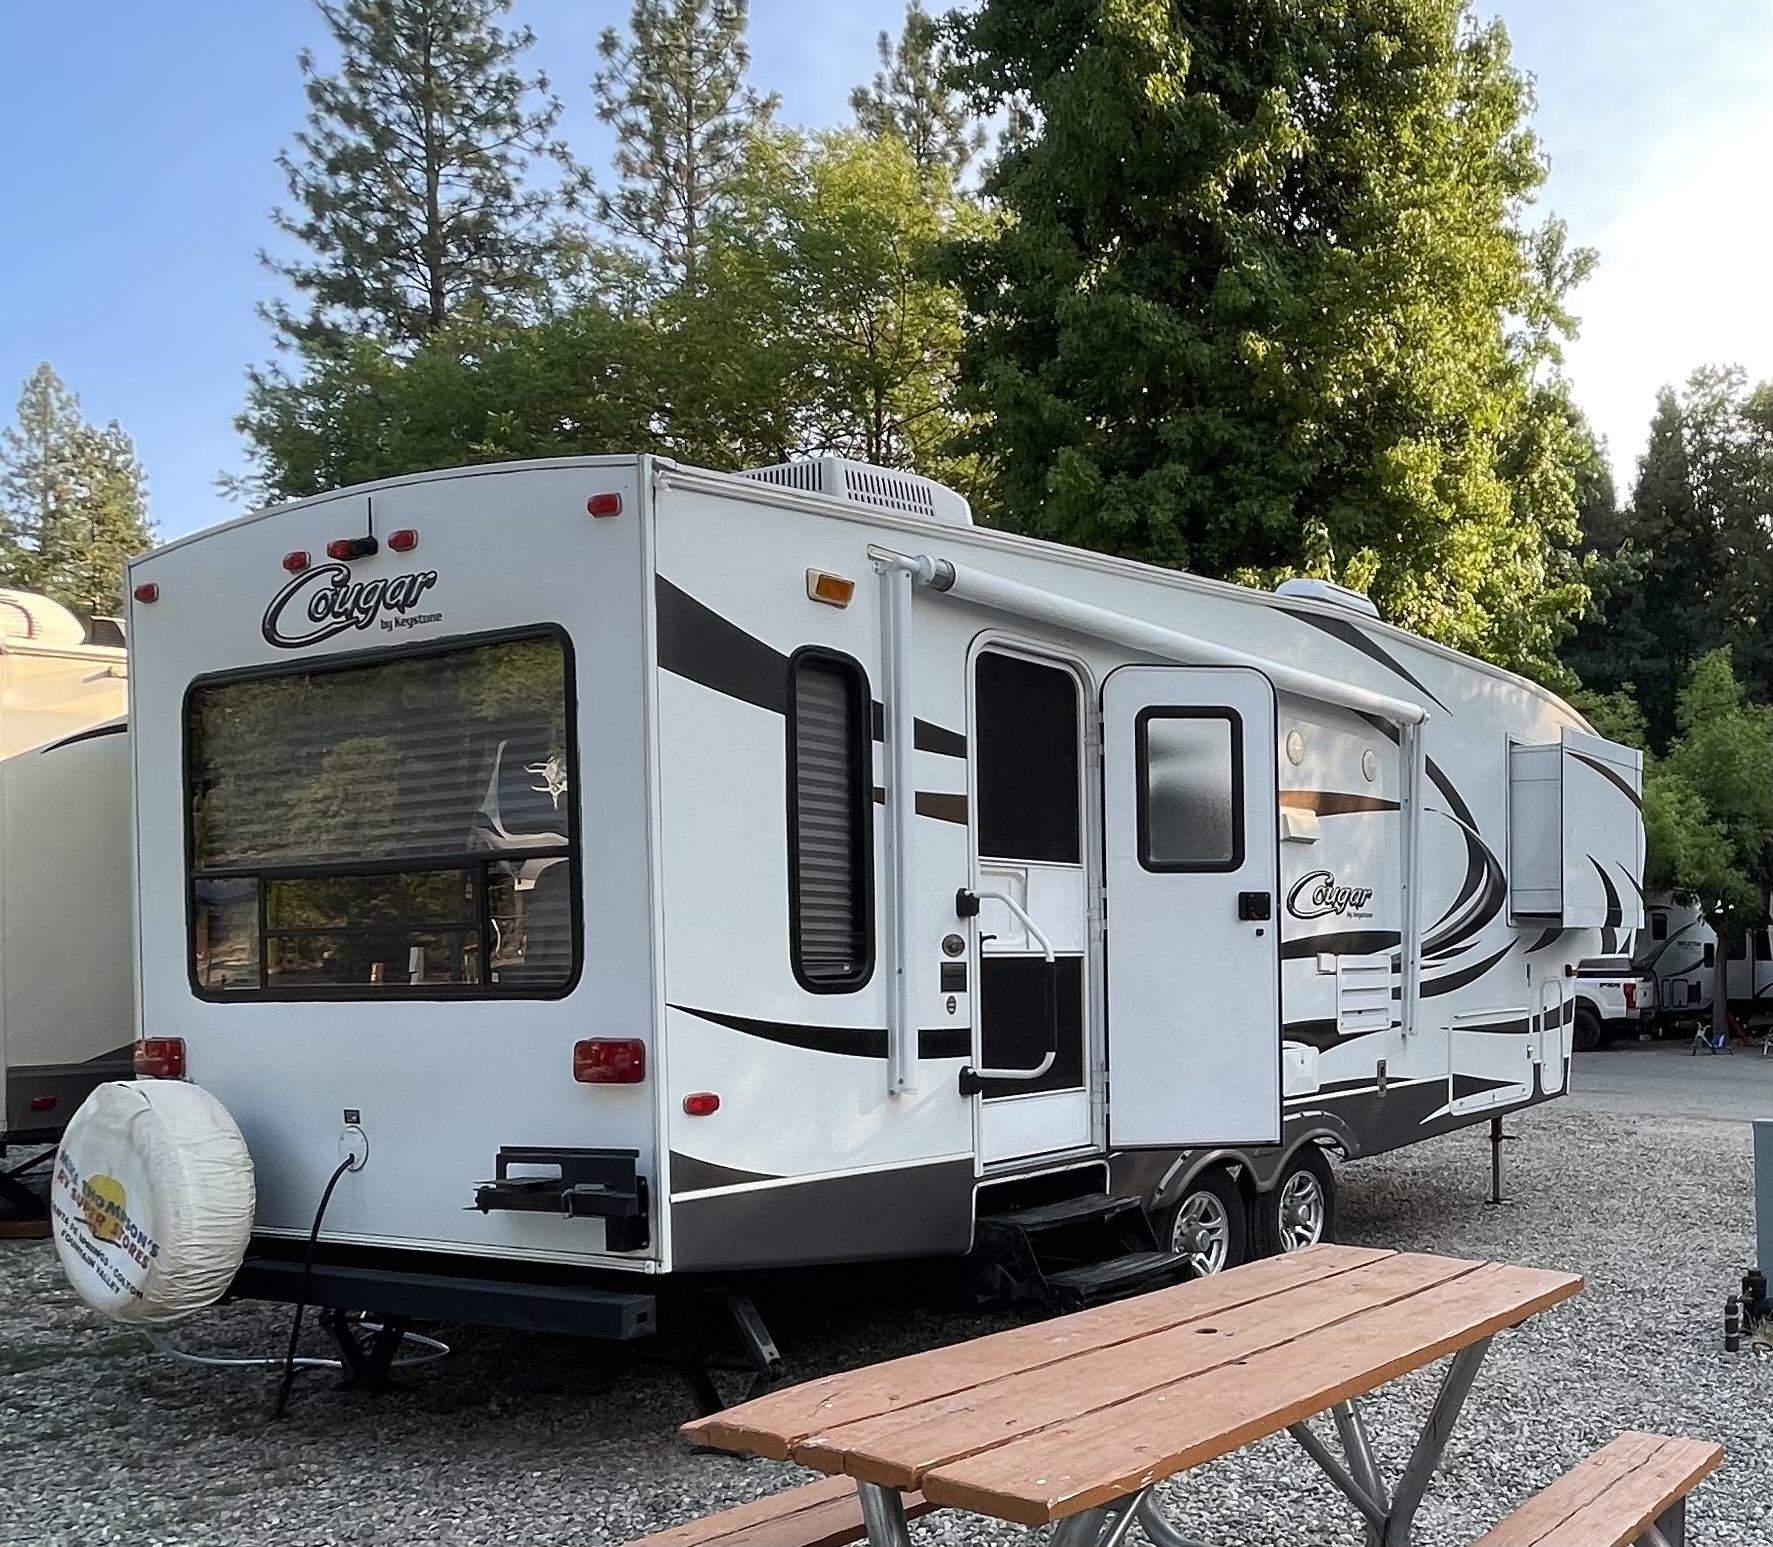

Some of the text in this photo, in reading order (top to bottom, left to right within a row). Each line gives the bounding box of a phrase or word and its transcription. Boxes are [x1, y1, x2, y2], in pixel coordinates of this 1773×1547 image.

[262, 563, 438, 649] Cougar
[380, 612, 443, 632] by Keystone
[1286, 870, 1373, 920] Cougar
